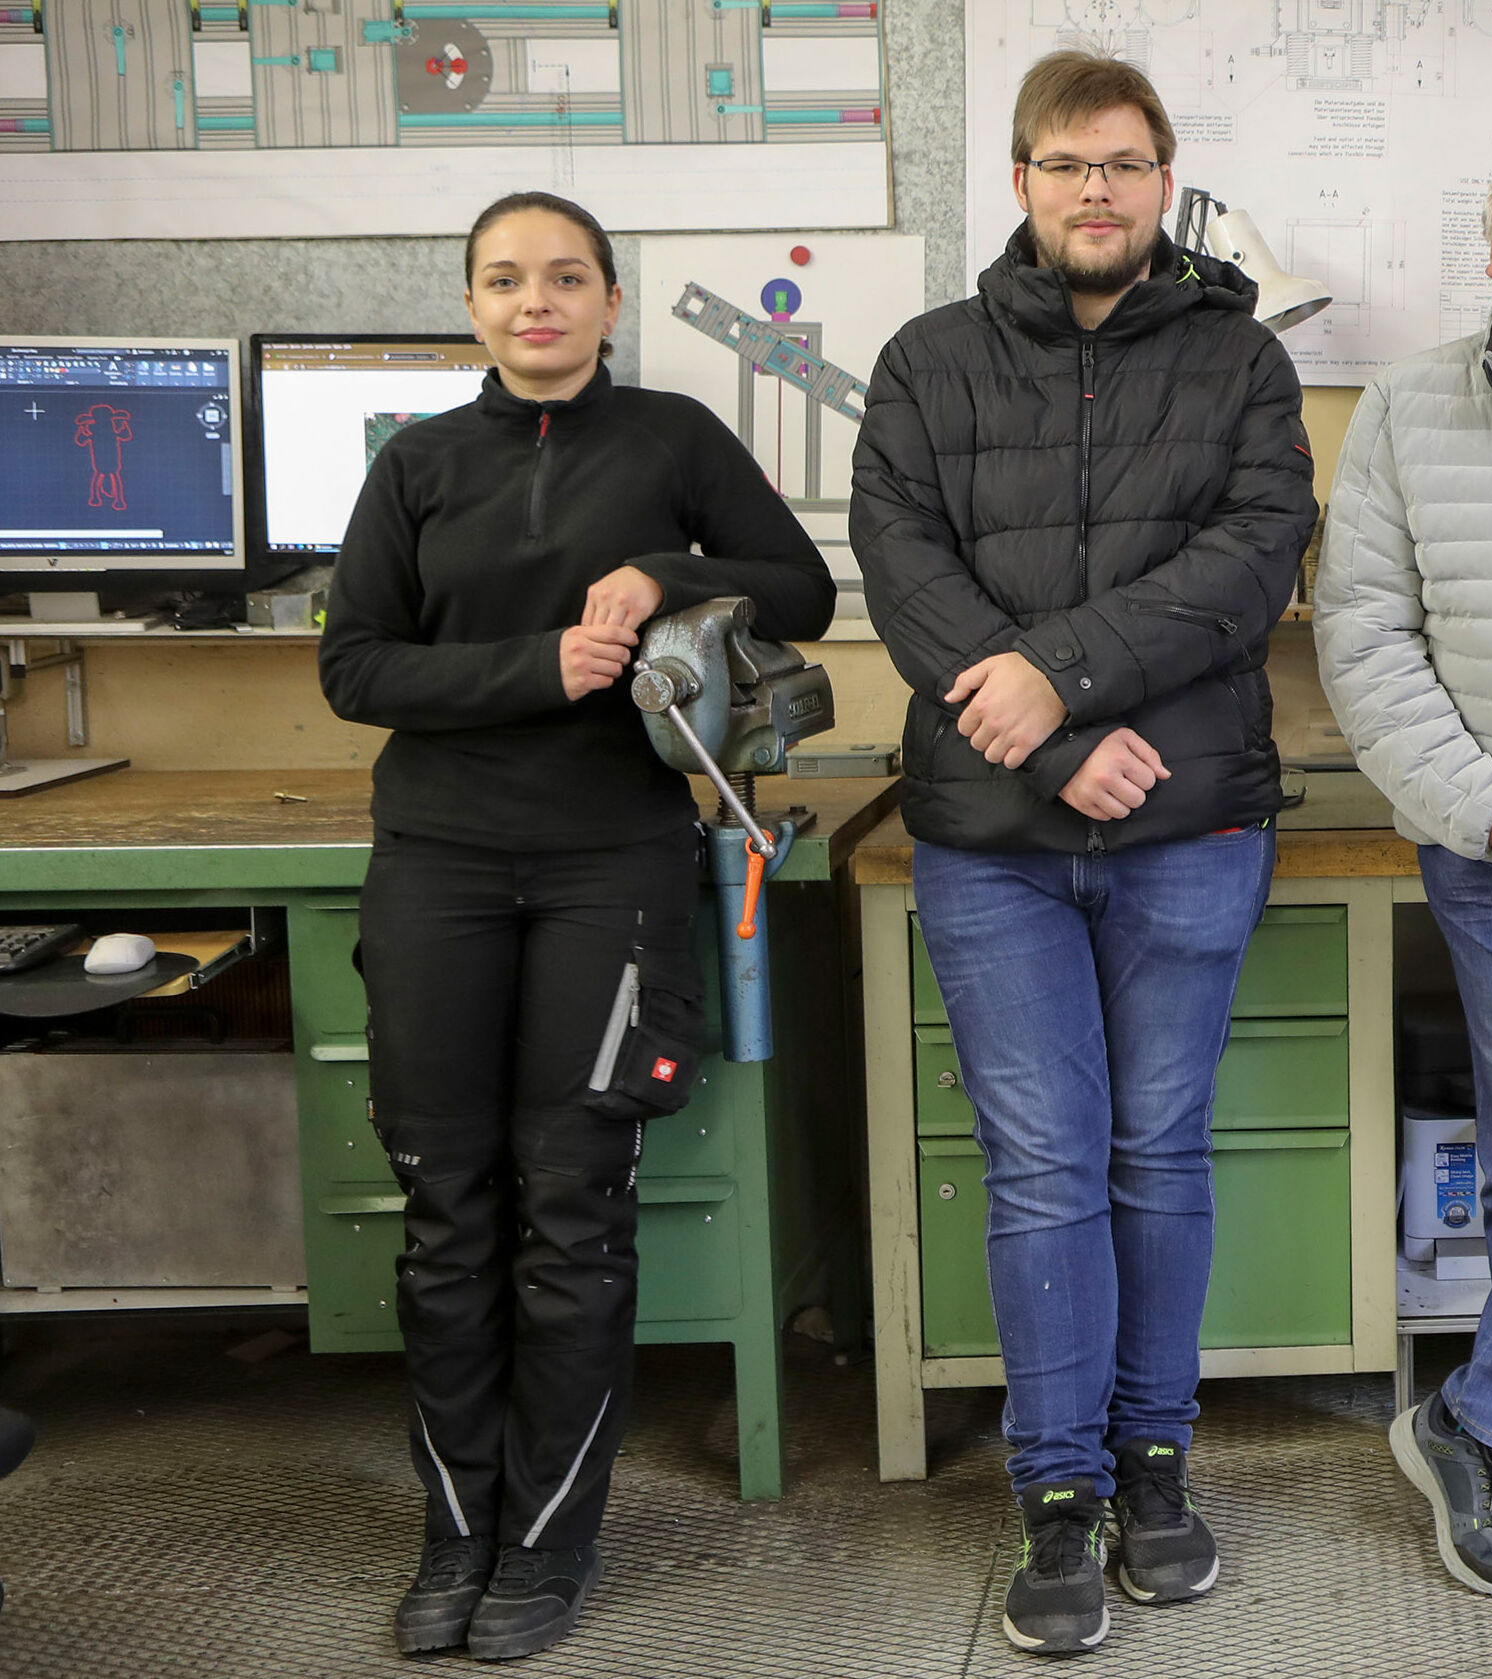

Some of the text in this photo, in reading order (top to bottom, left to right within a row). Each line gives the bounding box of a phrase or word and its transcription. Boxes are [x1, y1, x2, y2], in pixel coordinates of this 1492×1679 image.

[1319, 189, 1338, 198] A-A
[1157, 1447, 1174, 1456] asics
[1053, 1490, 1075, 1500] asics
